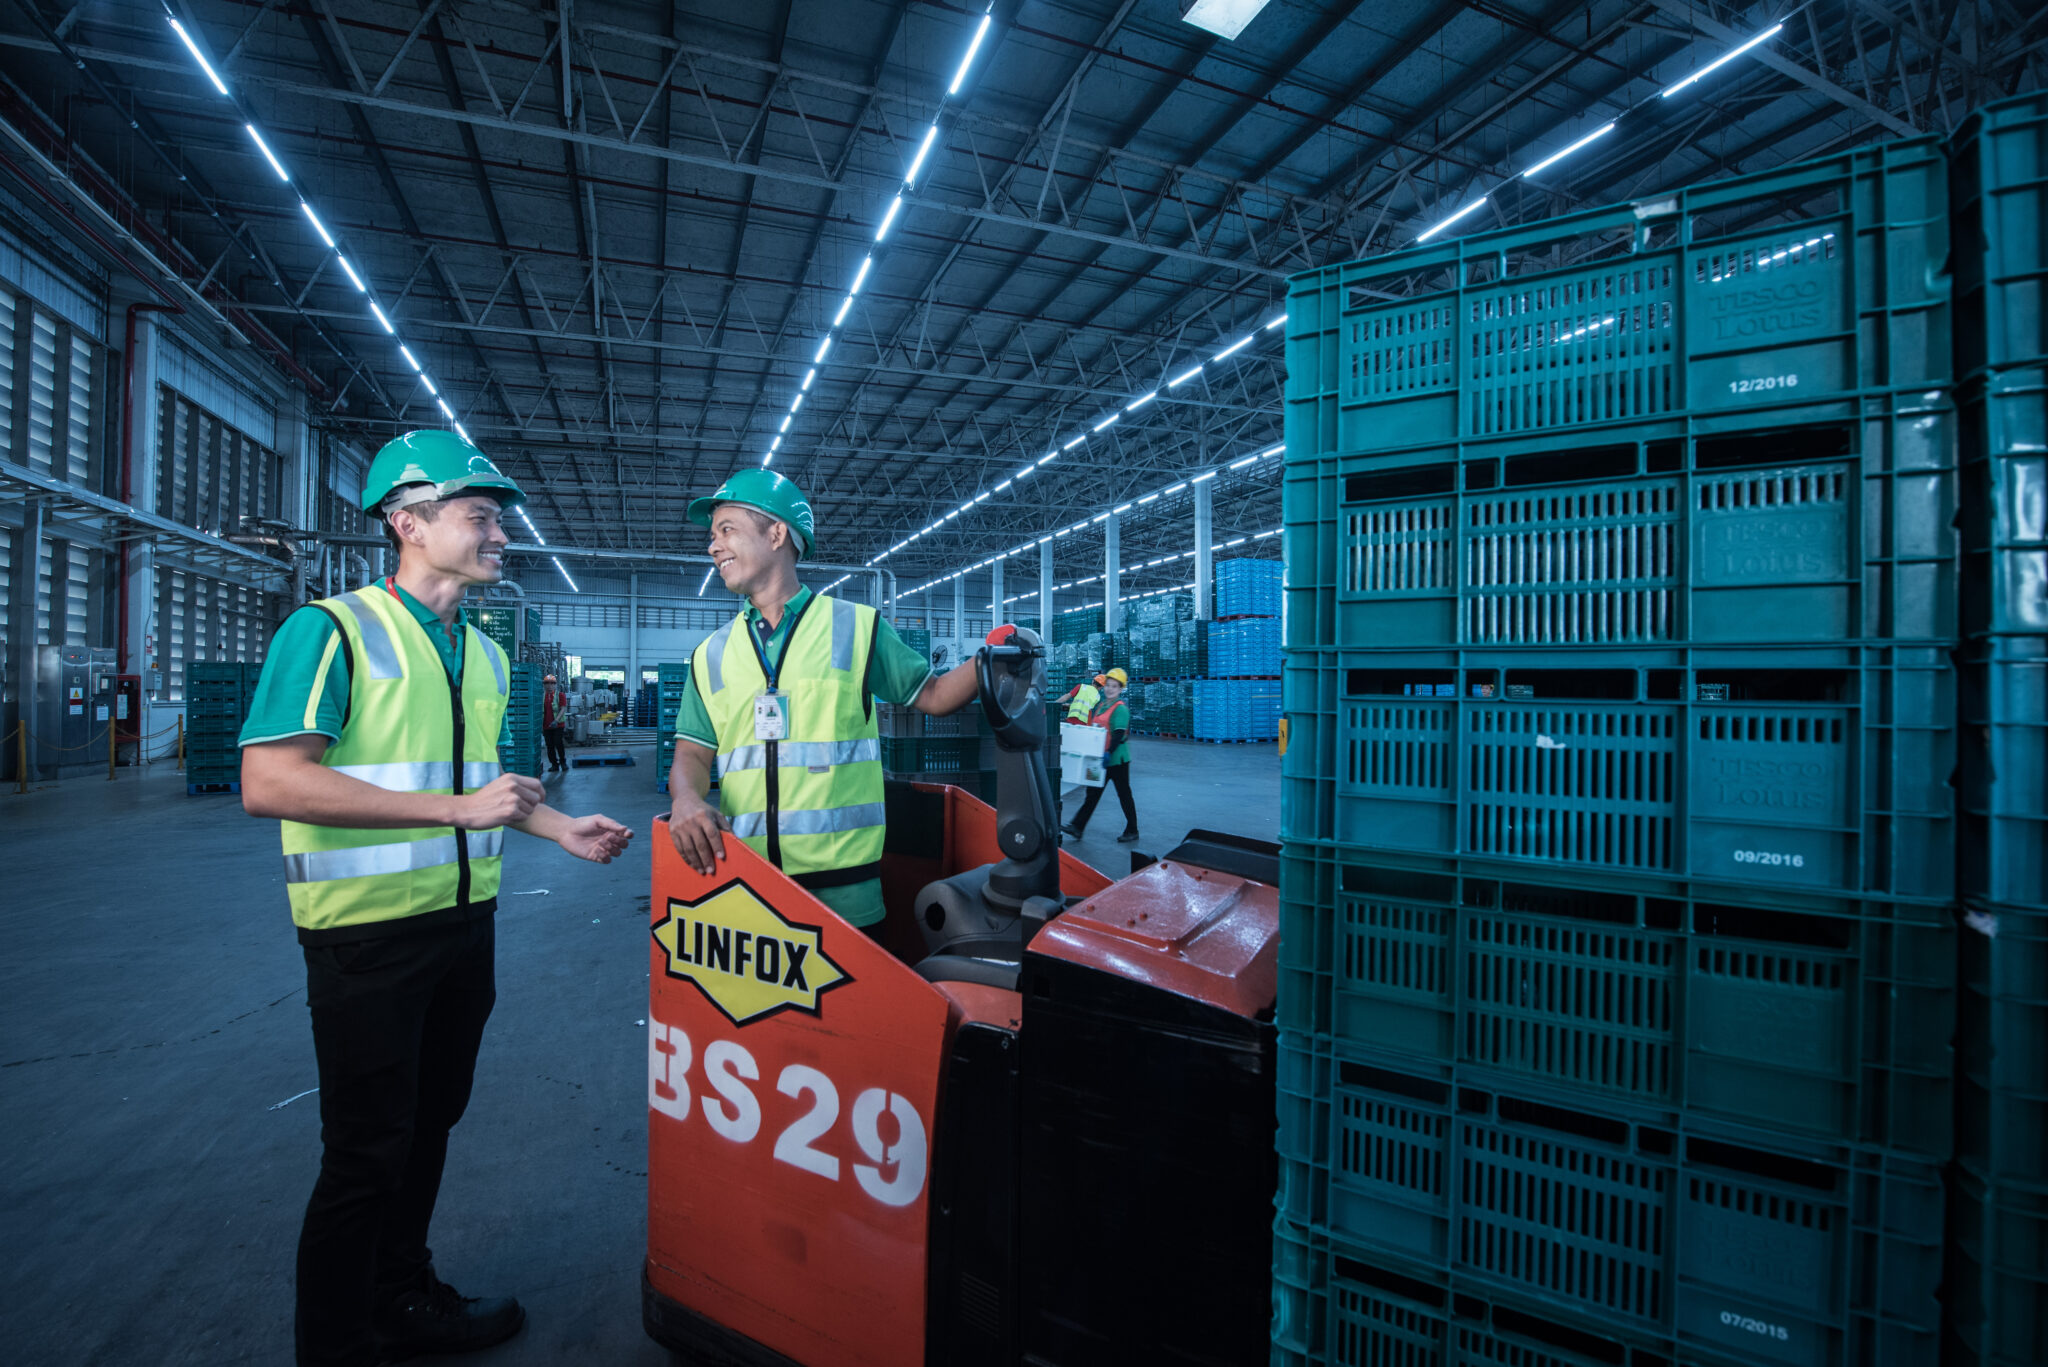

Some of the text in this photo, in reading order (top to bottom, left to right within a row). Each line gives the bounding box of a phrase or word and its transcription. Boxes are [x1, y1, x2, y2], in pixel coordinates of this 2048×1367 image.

[1709, 280, 1822, 311] TESCO
[1729, 374, 1798, 393] 12/2016
[1734, 849, 1804, 868] 09/2016
[677, 917, 810, 993] LINFOX
[649, 1020, 927, 1207] BS29
[1720, 1311, 1789, 1340] 07/2015
